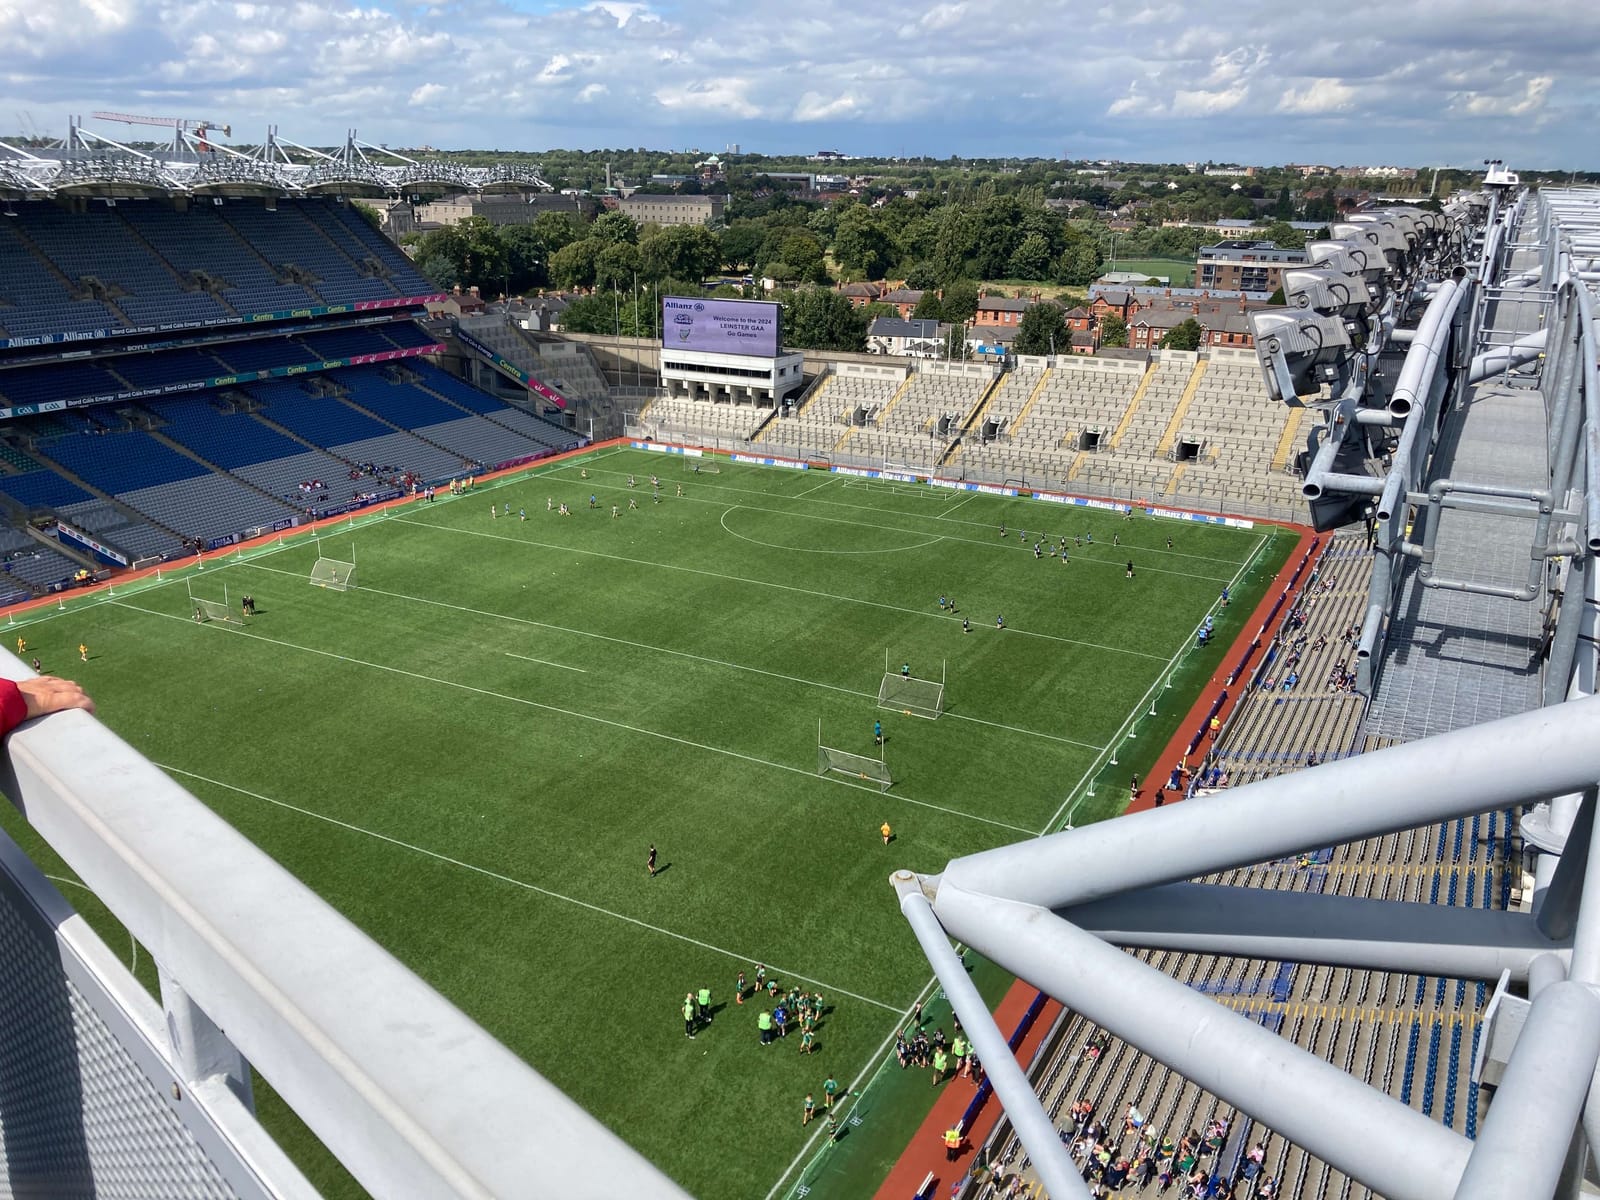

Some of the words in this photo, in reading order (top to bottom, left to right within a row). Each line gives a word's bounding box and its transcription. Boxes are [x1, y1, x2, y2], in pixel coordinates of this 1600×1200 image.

[665, 302, 692, 310] Allianz
[252, 312, 274, 321] Centra
[291, 309, 311, 317] Centra
[713, 315, 738, 323] Welcome
[720, 323, 750, 331] LEINSTER
[63, 331, 94, 342] Allianz
[8, 337, 40, 348] Allianz
[287, 365, 307, 374] Centra
[500, 360, 521, 377] Centra
[214, 377, 237, 385] Centra
[1038, 493, 1064, 503] Allianz
[1086, 500, 1114, 510] Allianz
[1152, 508, 1181, 519] Allianz
